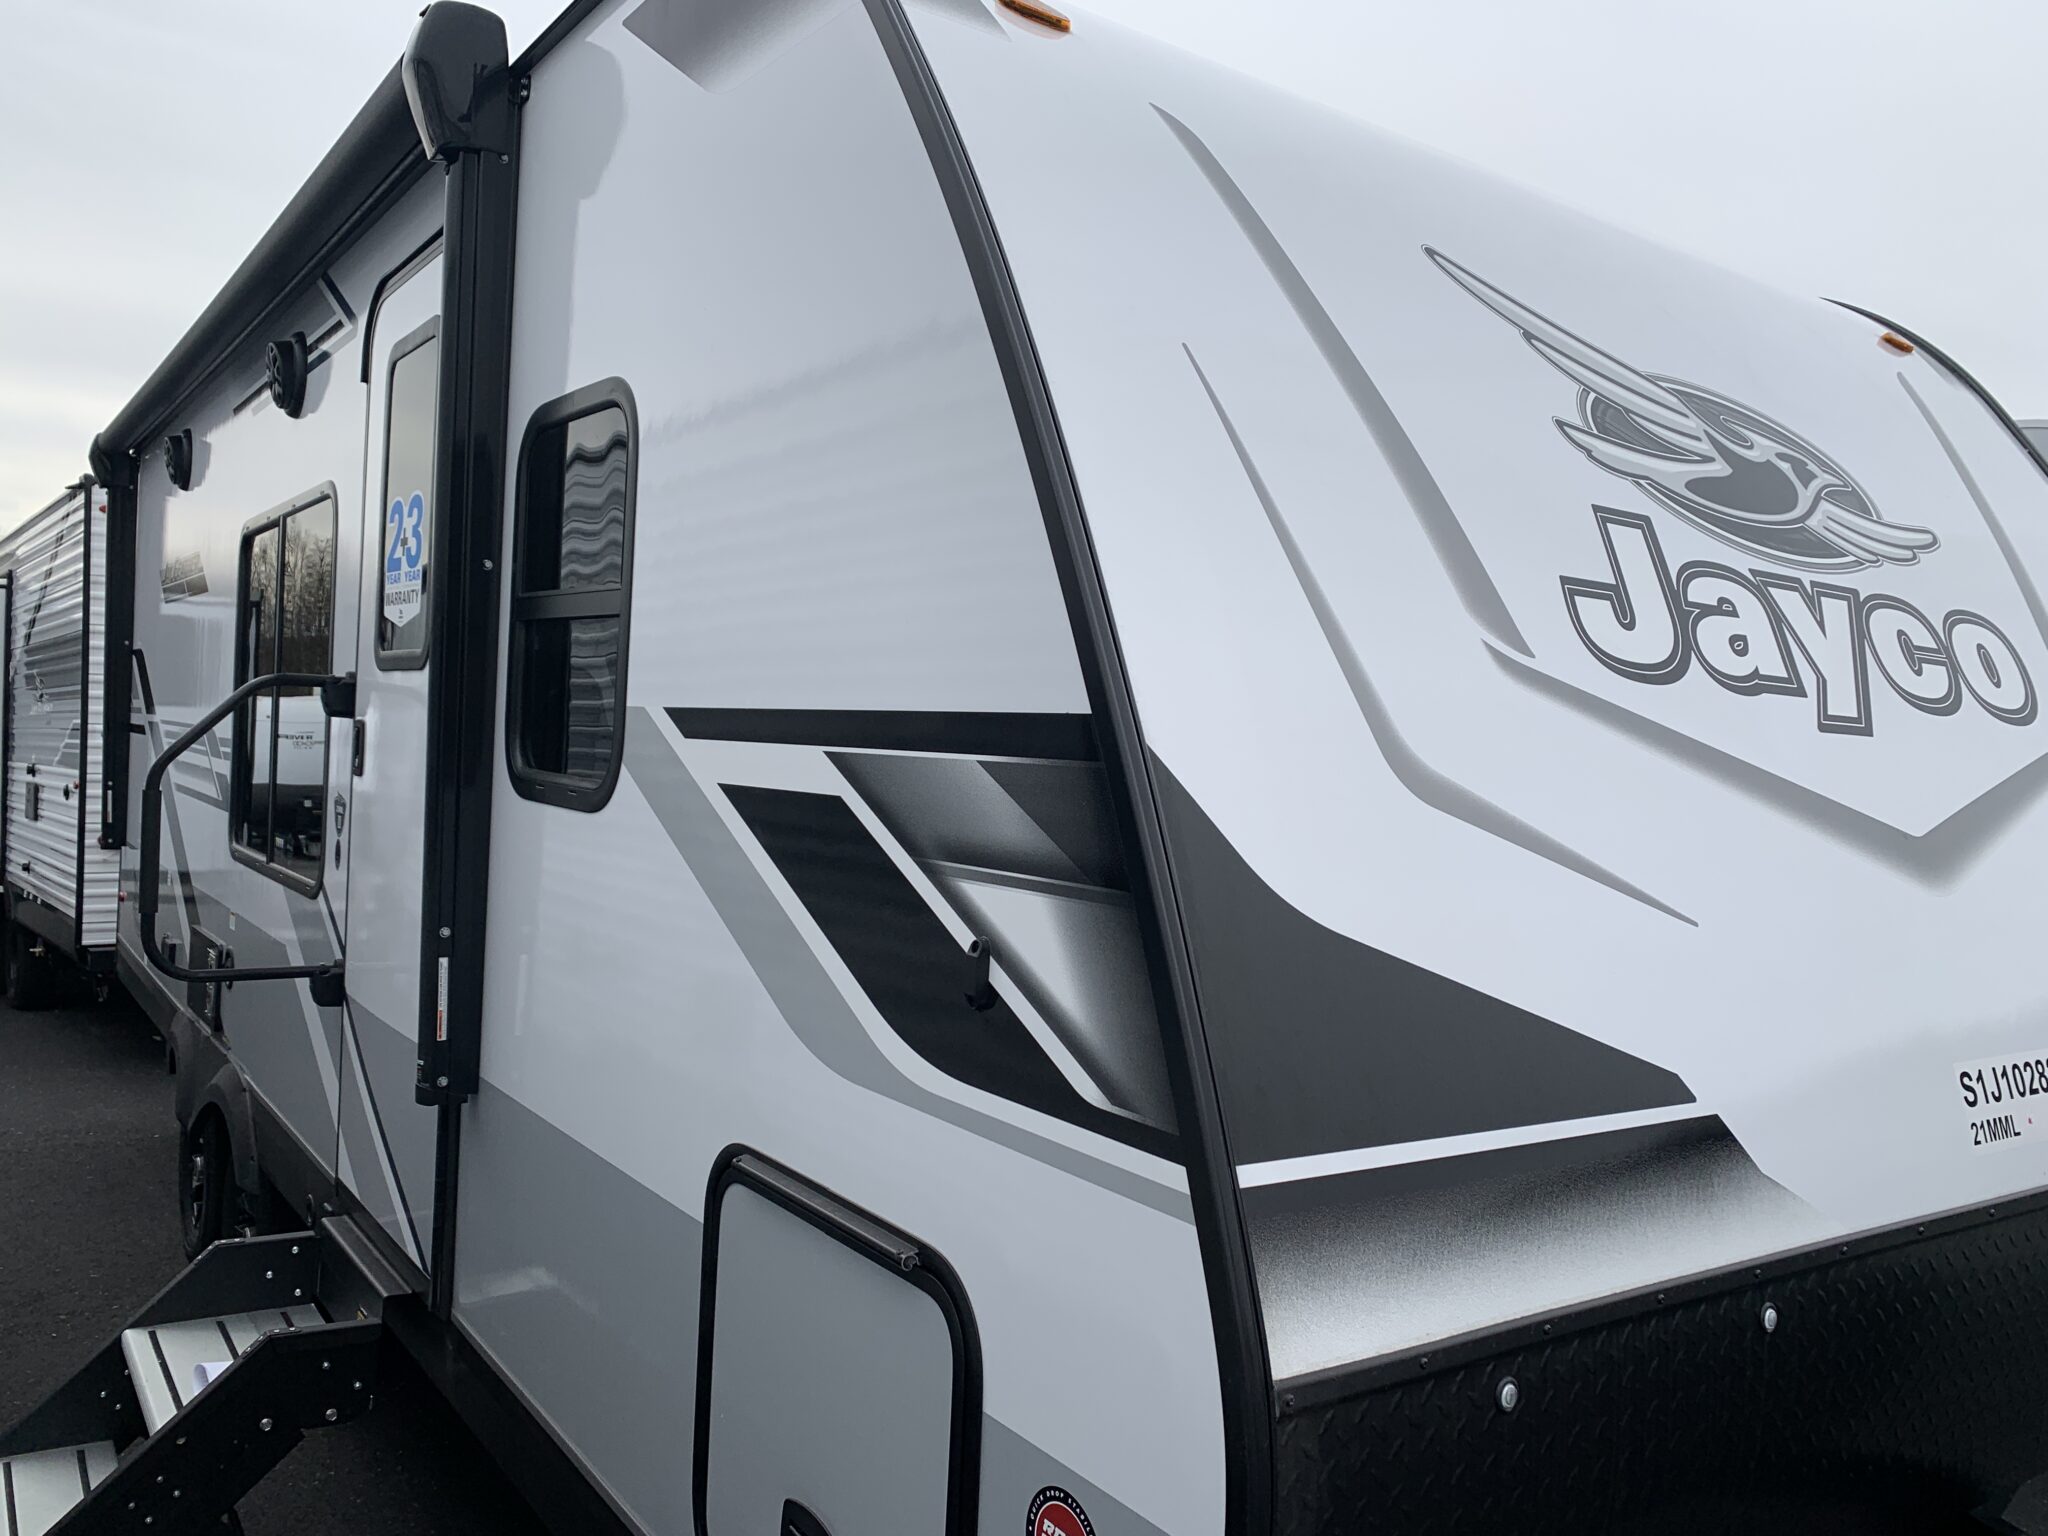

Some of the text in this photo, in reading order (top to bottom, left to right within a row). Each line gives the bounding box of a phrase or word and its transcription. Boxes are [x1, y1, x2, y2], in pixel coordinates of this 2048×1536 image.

[386, 569, 421, 585] YEAR YEAR
[386, 589, 419, 607] WARRANTY
[1559, 504, 2038, 737] Jayco
[1960, 1058, 2048, 1108] S1J1028
[1970, 1114, 2022, 1146] 21MML
[1030, 1494, 1044, 1520] QUICK
[1046, 1490, 1064, 1498] DROP
